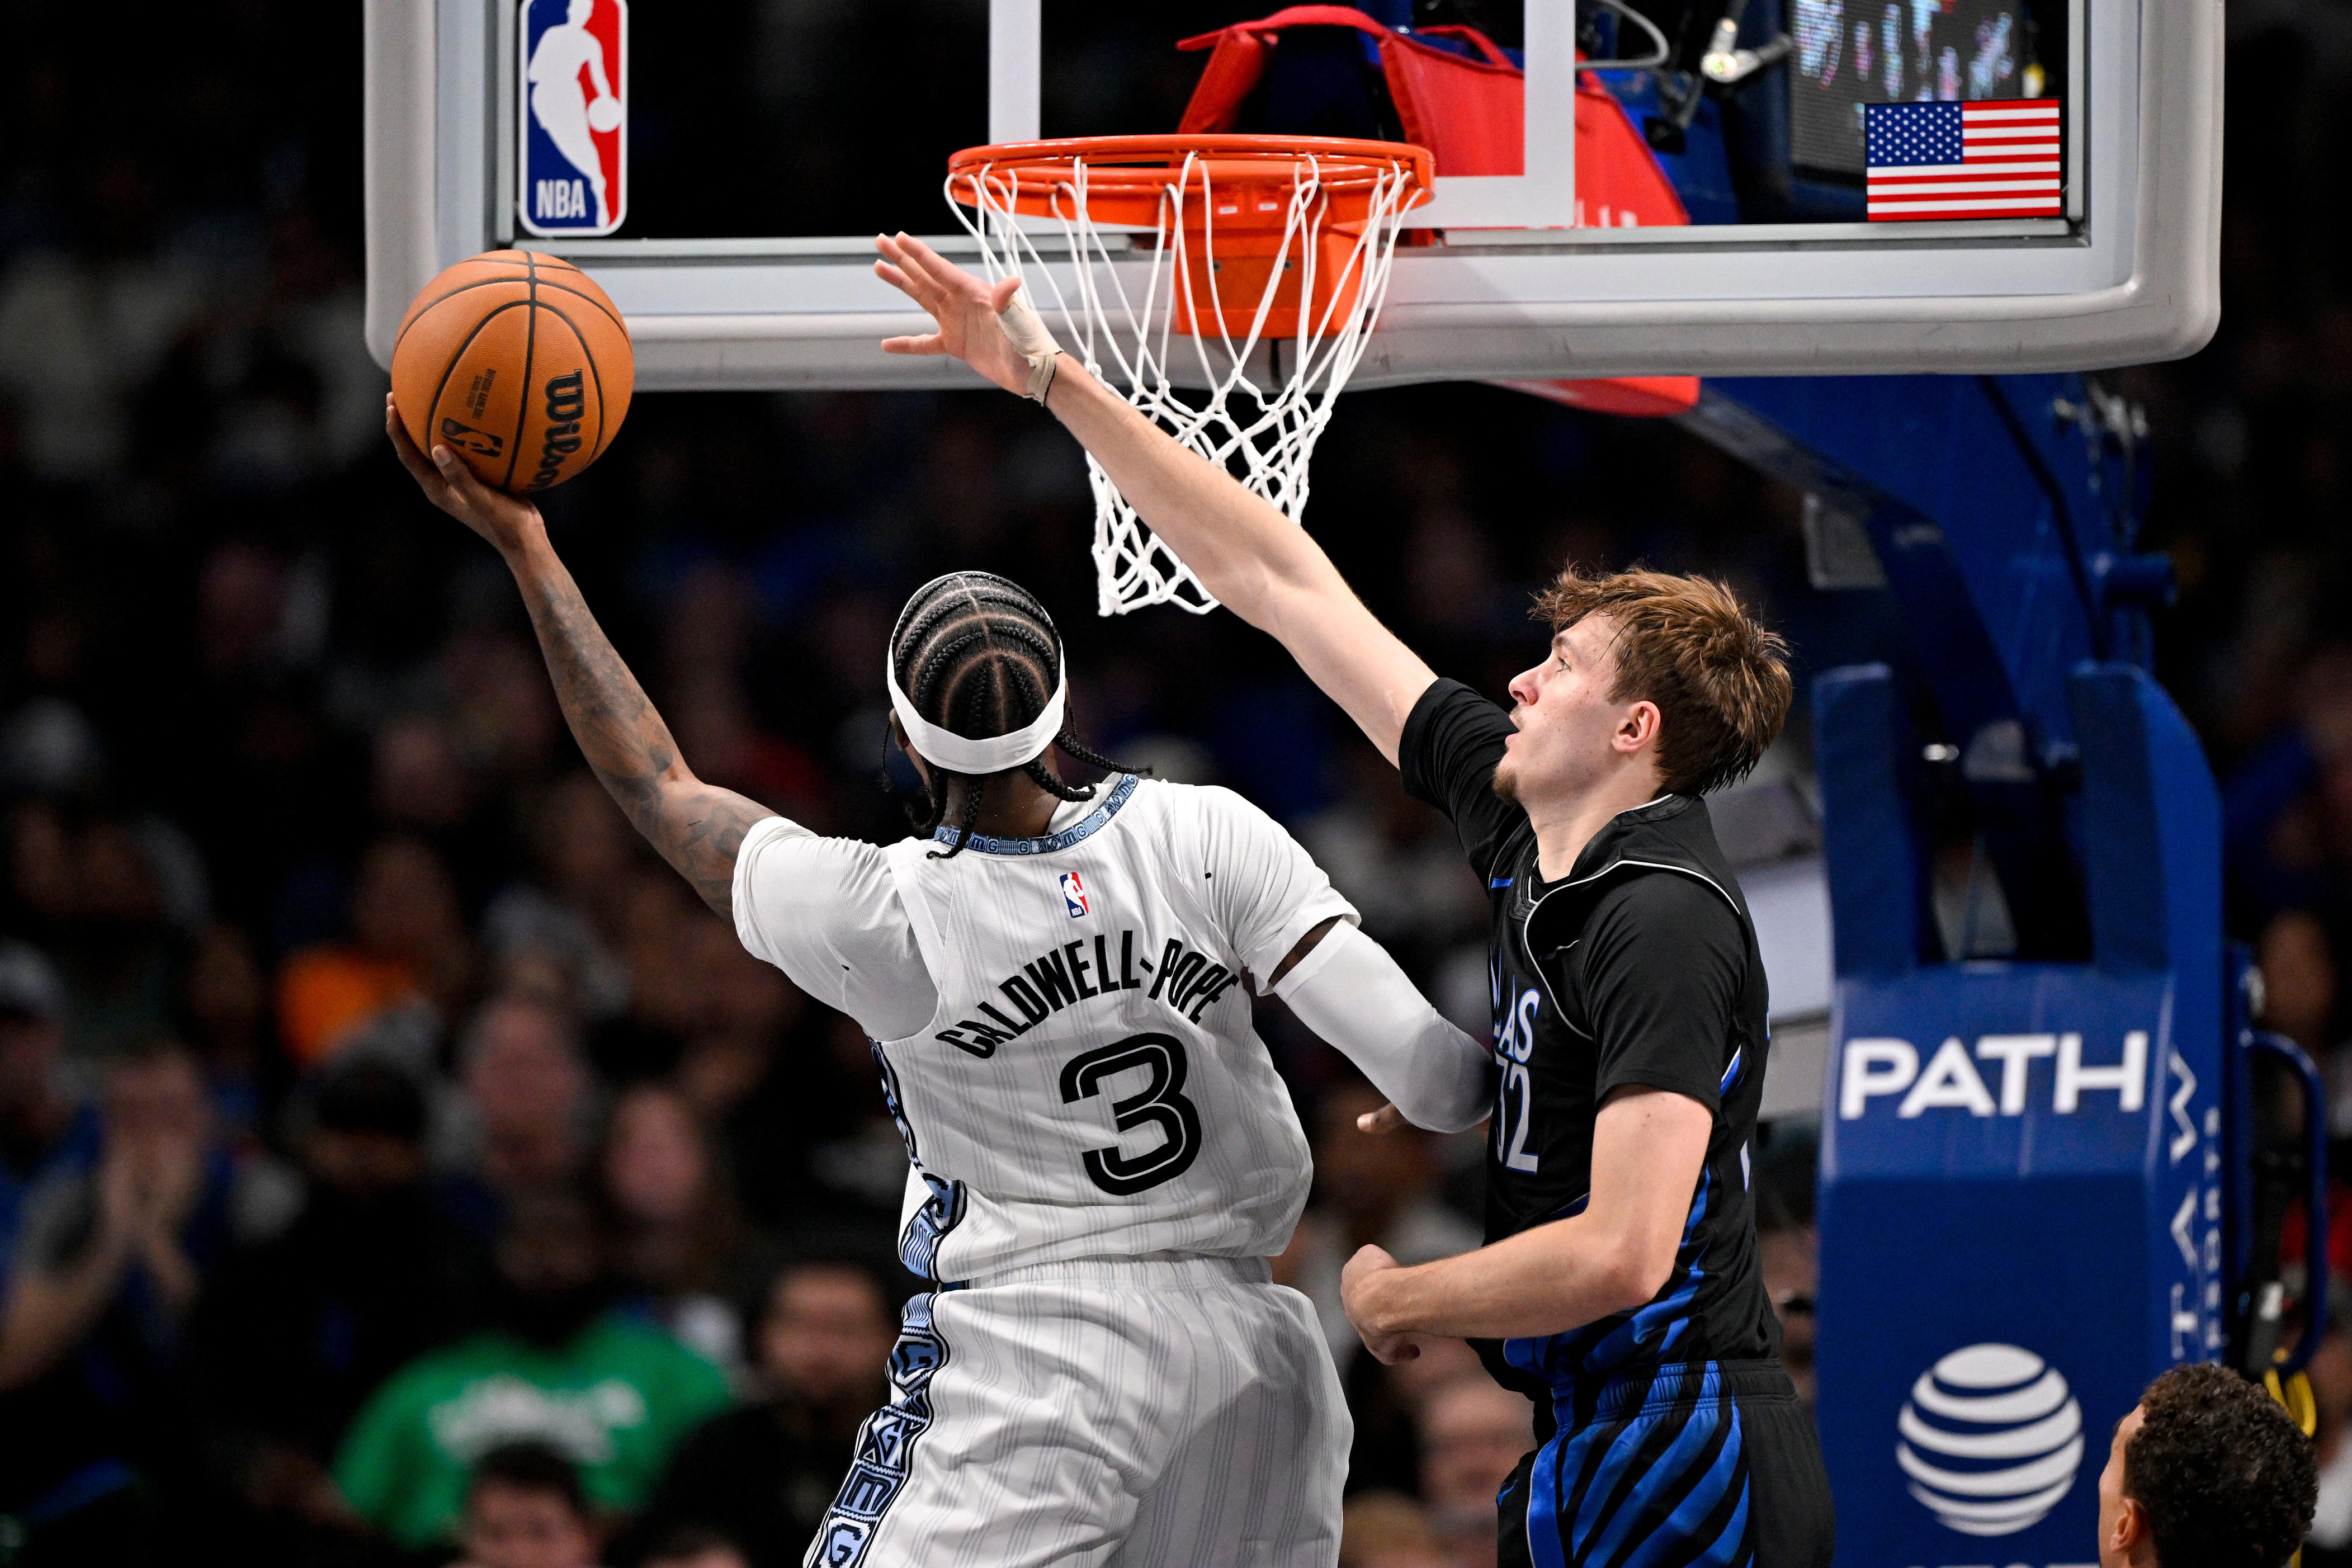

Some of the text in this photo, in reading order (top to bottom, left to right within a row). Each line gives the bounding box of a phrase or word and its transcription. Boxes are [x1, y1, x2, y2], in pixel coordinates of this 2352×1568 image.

[536, 178, 586, 219] NBA
[1071, 906, 1083, 917] NBA
[936, 930, 1240, 1059] CALDWELL-POPE
[1059, 1032, 1202, 1196] 3
[1840, 1030, 2149, 1120] PATH
[2170, 1049, 2198, 1360] TAW
